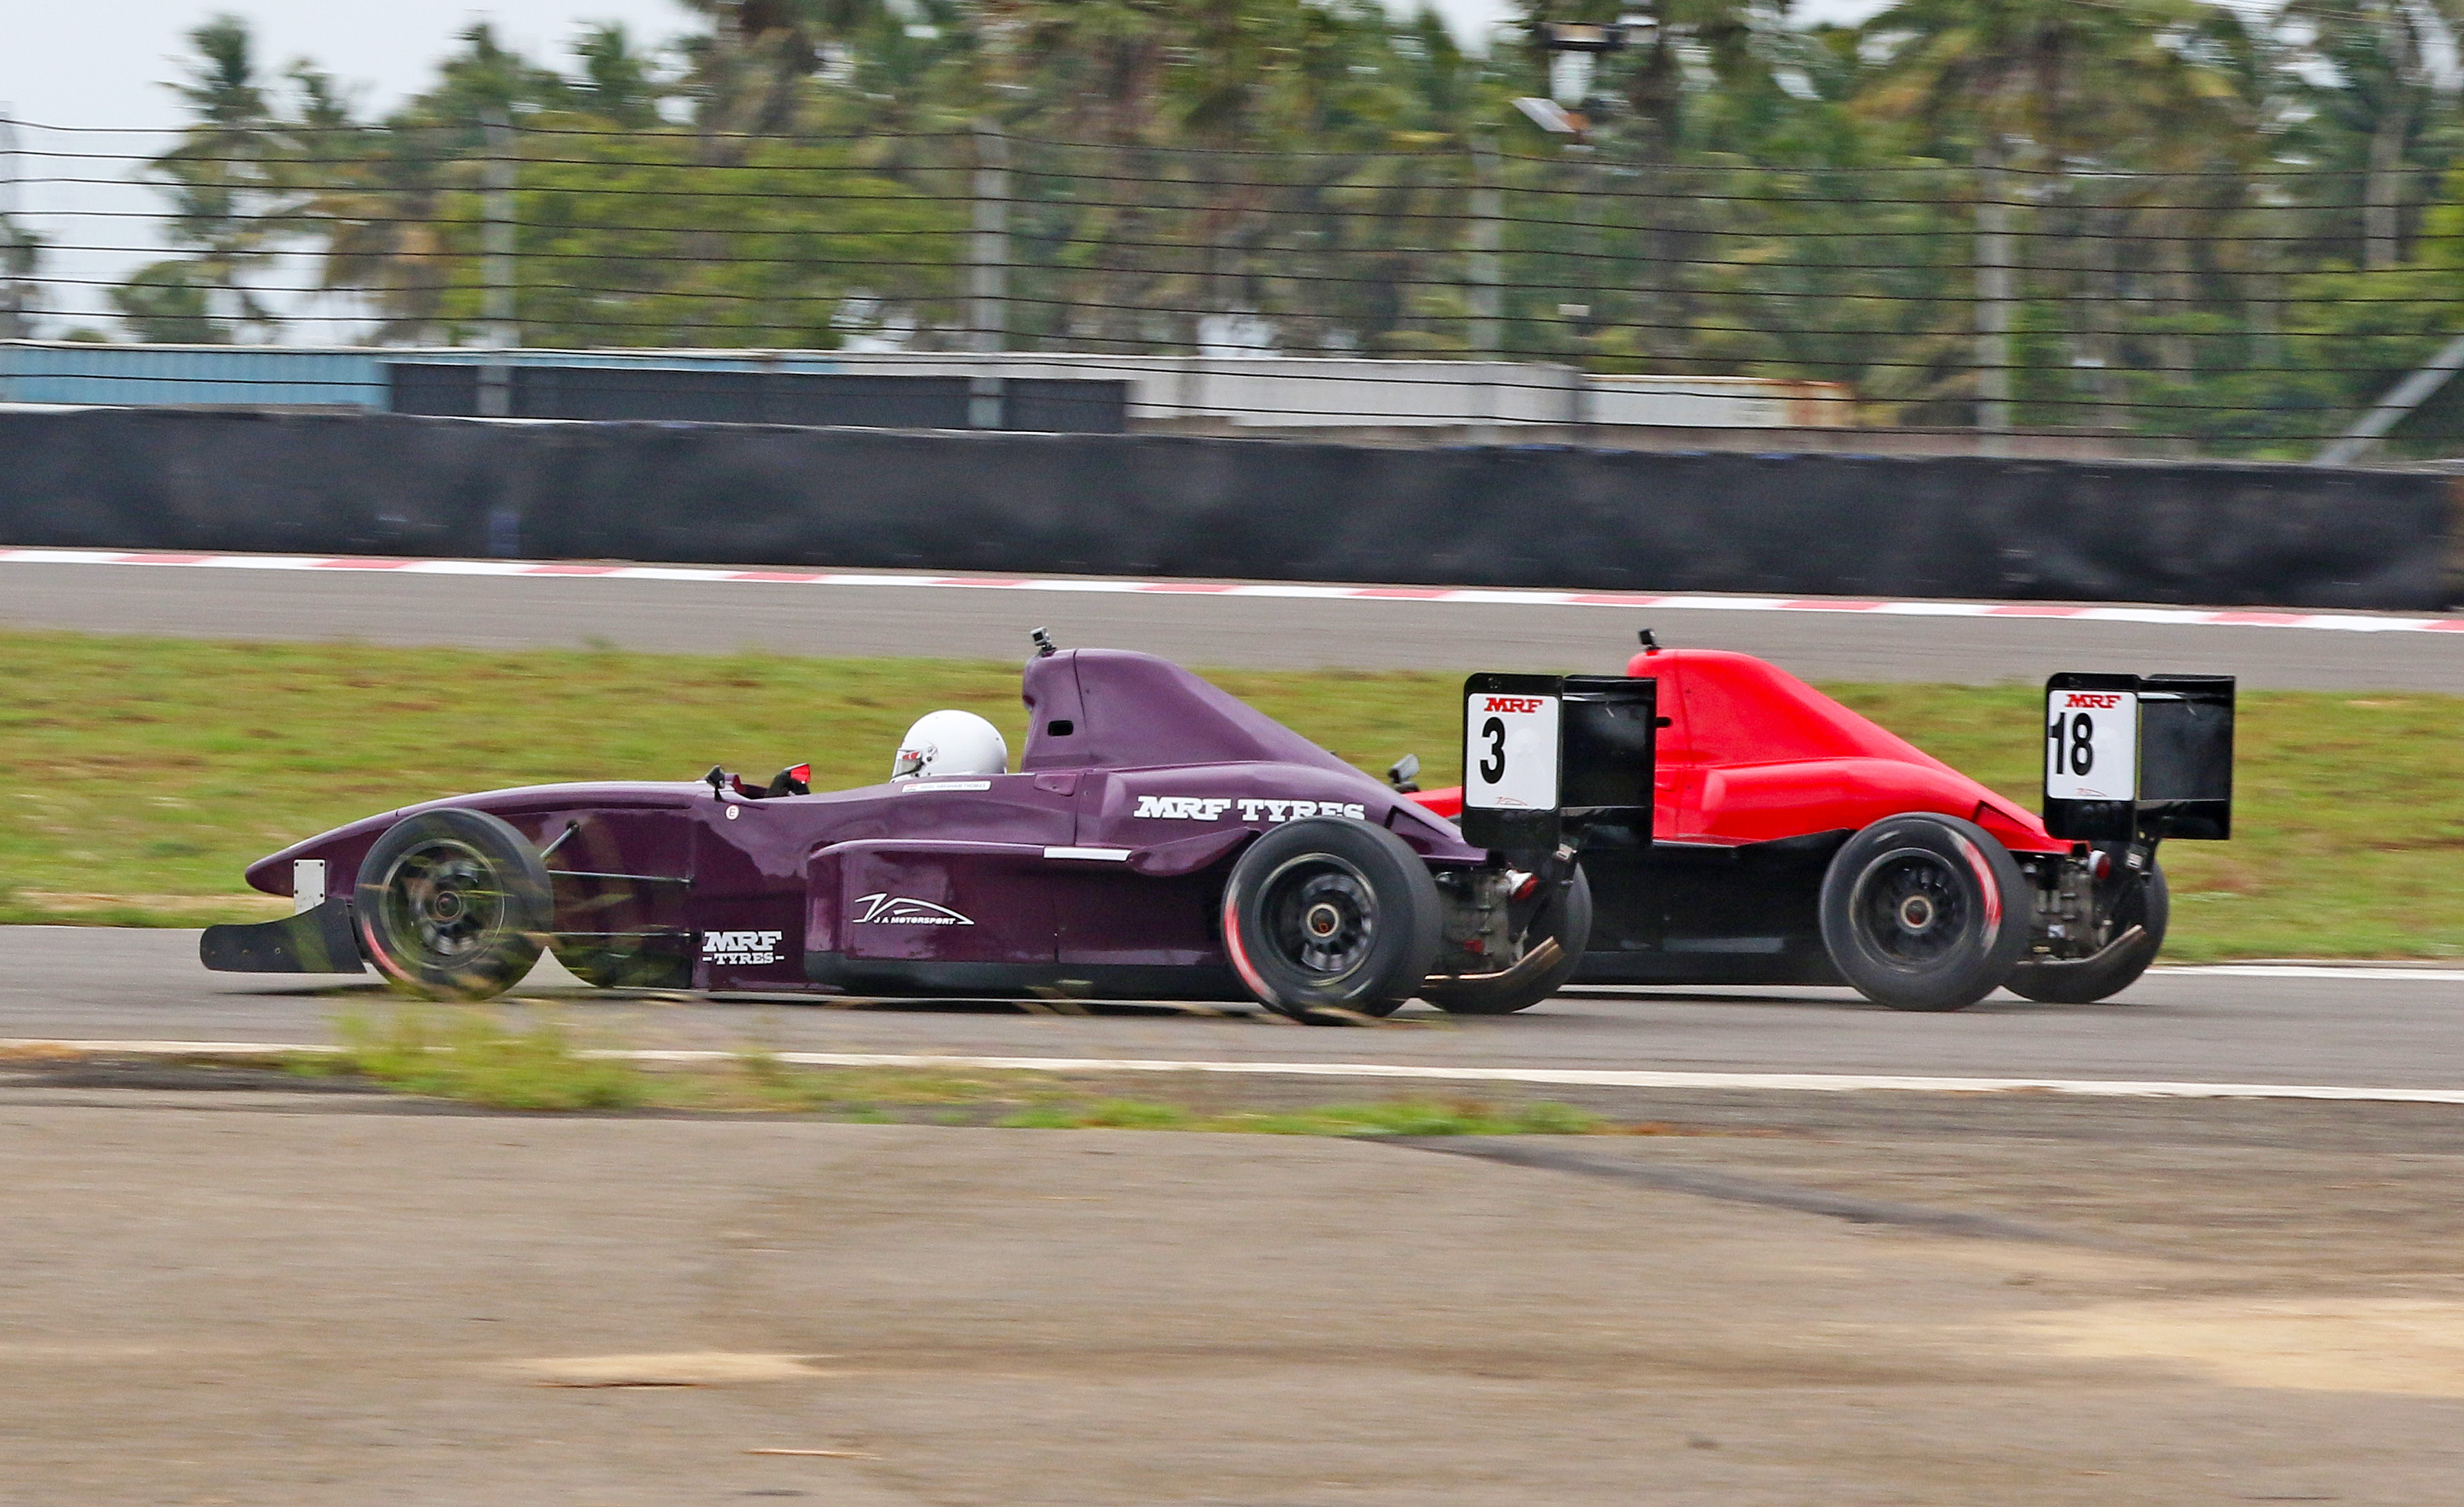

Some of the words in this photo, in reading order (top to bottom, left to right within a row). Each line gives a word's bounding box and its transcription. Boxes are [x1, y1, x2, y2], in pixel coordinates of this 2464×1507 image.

[1484, 698, 1543, 713] MRF
[2065, 694, 2122, 709] MRF
[1480, 717, 1505, 784] 3
[2049, 711, 2093, 776] 18
[729, 808, 736, 817] E
[1134, 796, 1231, 821] MRF
[1238, 799, 1365, 822] TYRES
[890, 917, 956, 925] MOTORSPORT
[702, 931, 782, 952] MRF
